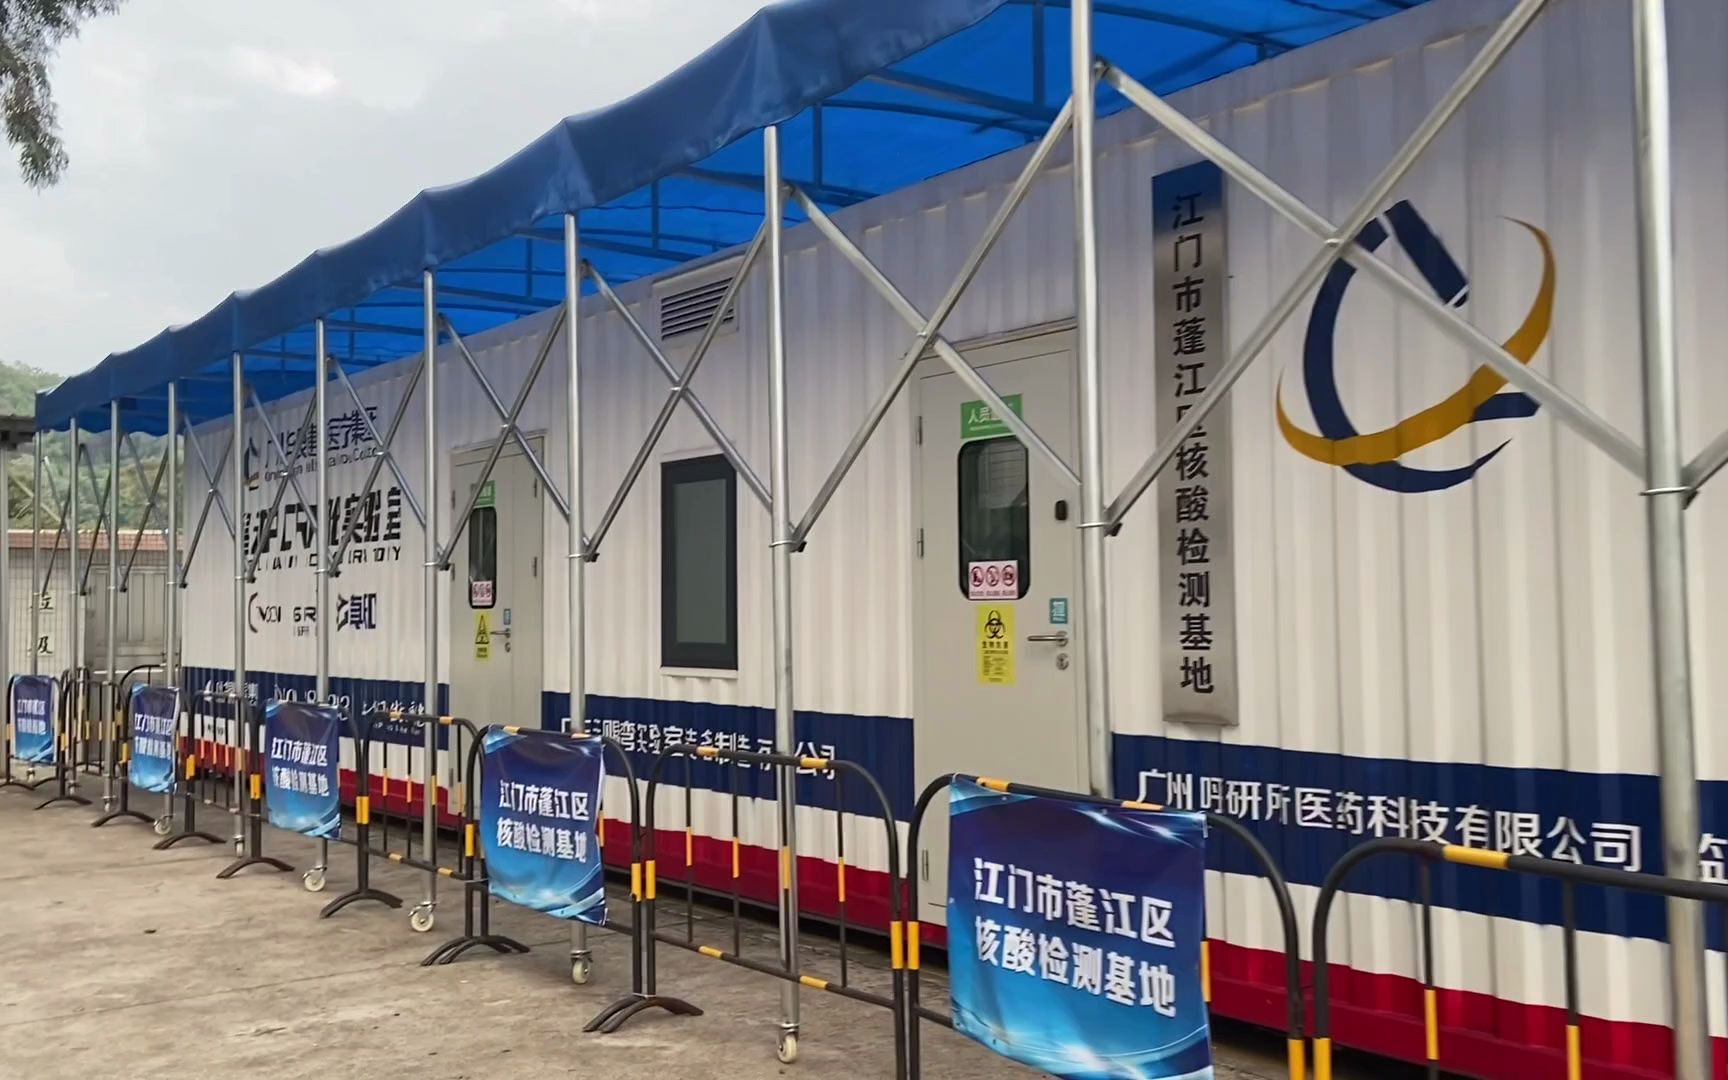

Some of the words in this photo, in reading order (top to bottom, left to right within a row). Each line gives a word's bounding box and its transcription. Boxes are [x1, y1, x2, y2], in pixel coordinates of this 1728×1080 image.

[499, 780, 590, 822] 江门市蓬江区
[496, 816, 588, 864] 核酸检测基地
[974, 857, 1176, 948] 江门市蓬江区
[974, 915, 1177, 1018] 核酸检测基地
